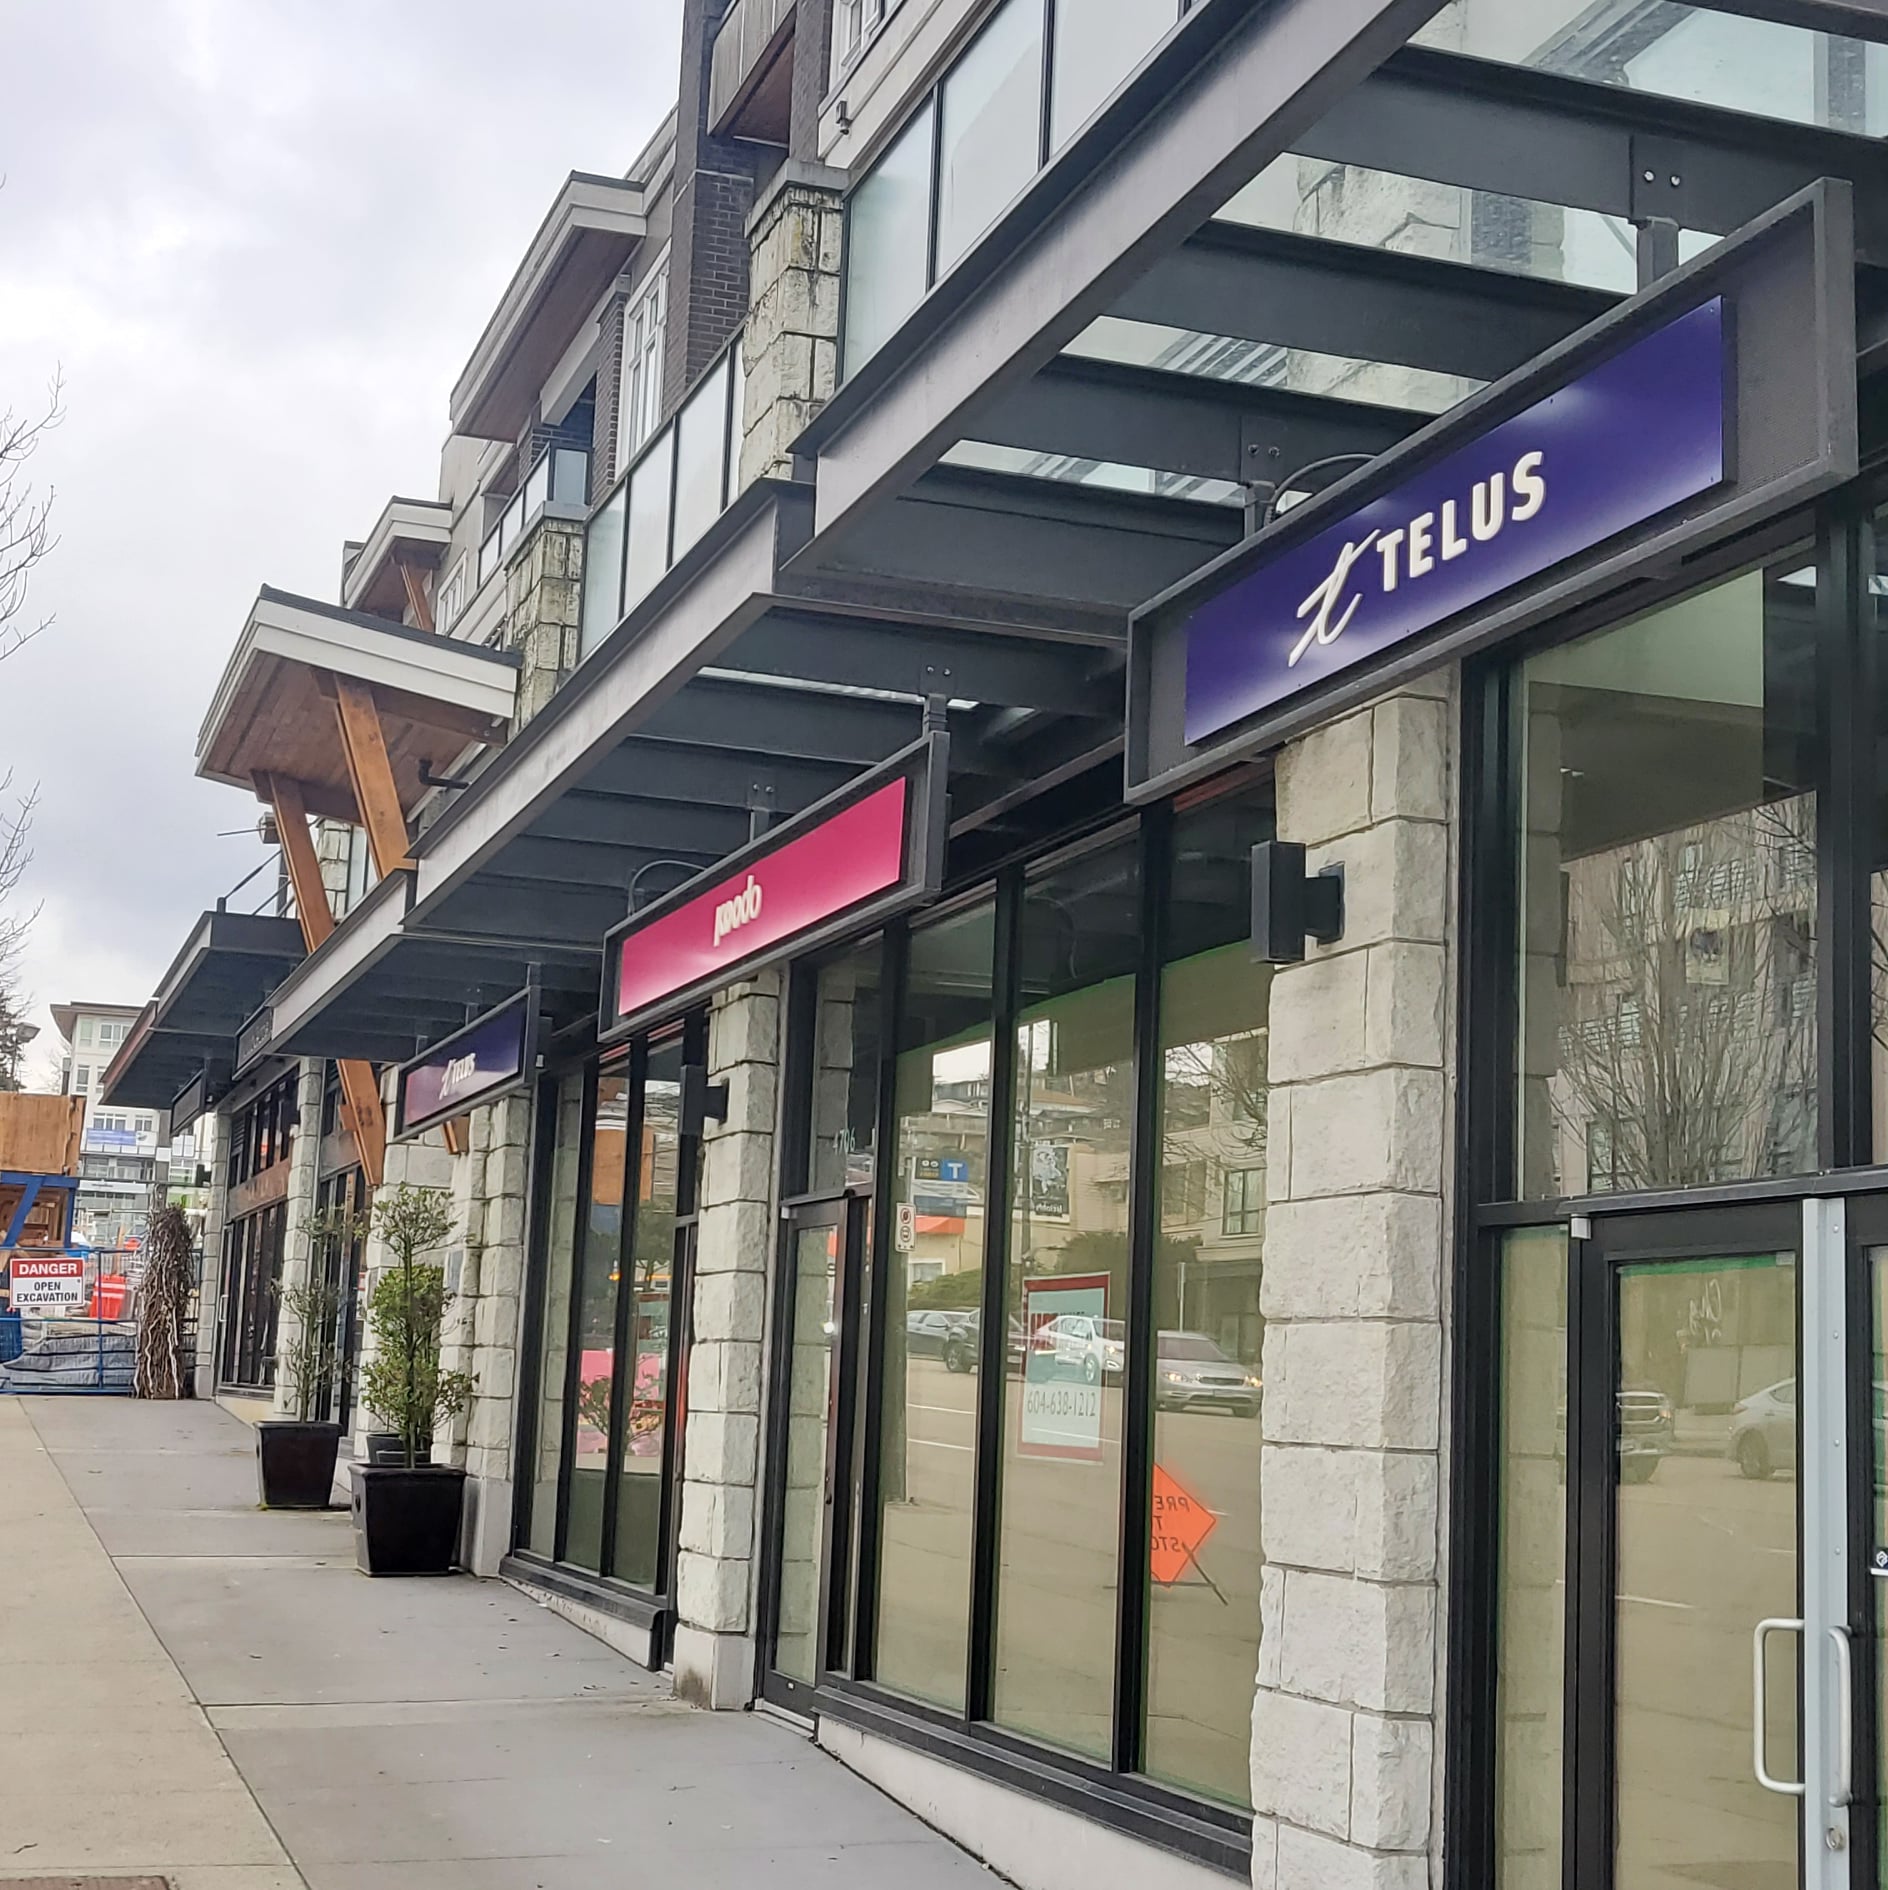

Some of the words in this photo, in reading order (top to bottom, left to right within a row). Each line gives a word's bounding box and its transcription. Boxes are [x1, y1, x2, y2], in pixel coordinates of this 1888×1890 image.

[1376, 450, 1547, 592] TELUS
[18, 1263, 78, 1276] DANGER
[33, 1281, 61, 1291] OPEN
[16, 1292, 78, 1303] EXCAVATION
[1026, 1390, 1097, 1417] 604-638-1212
